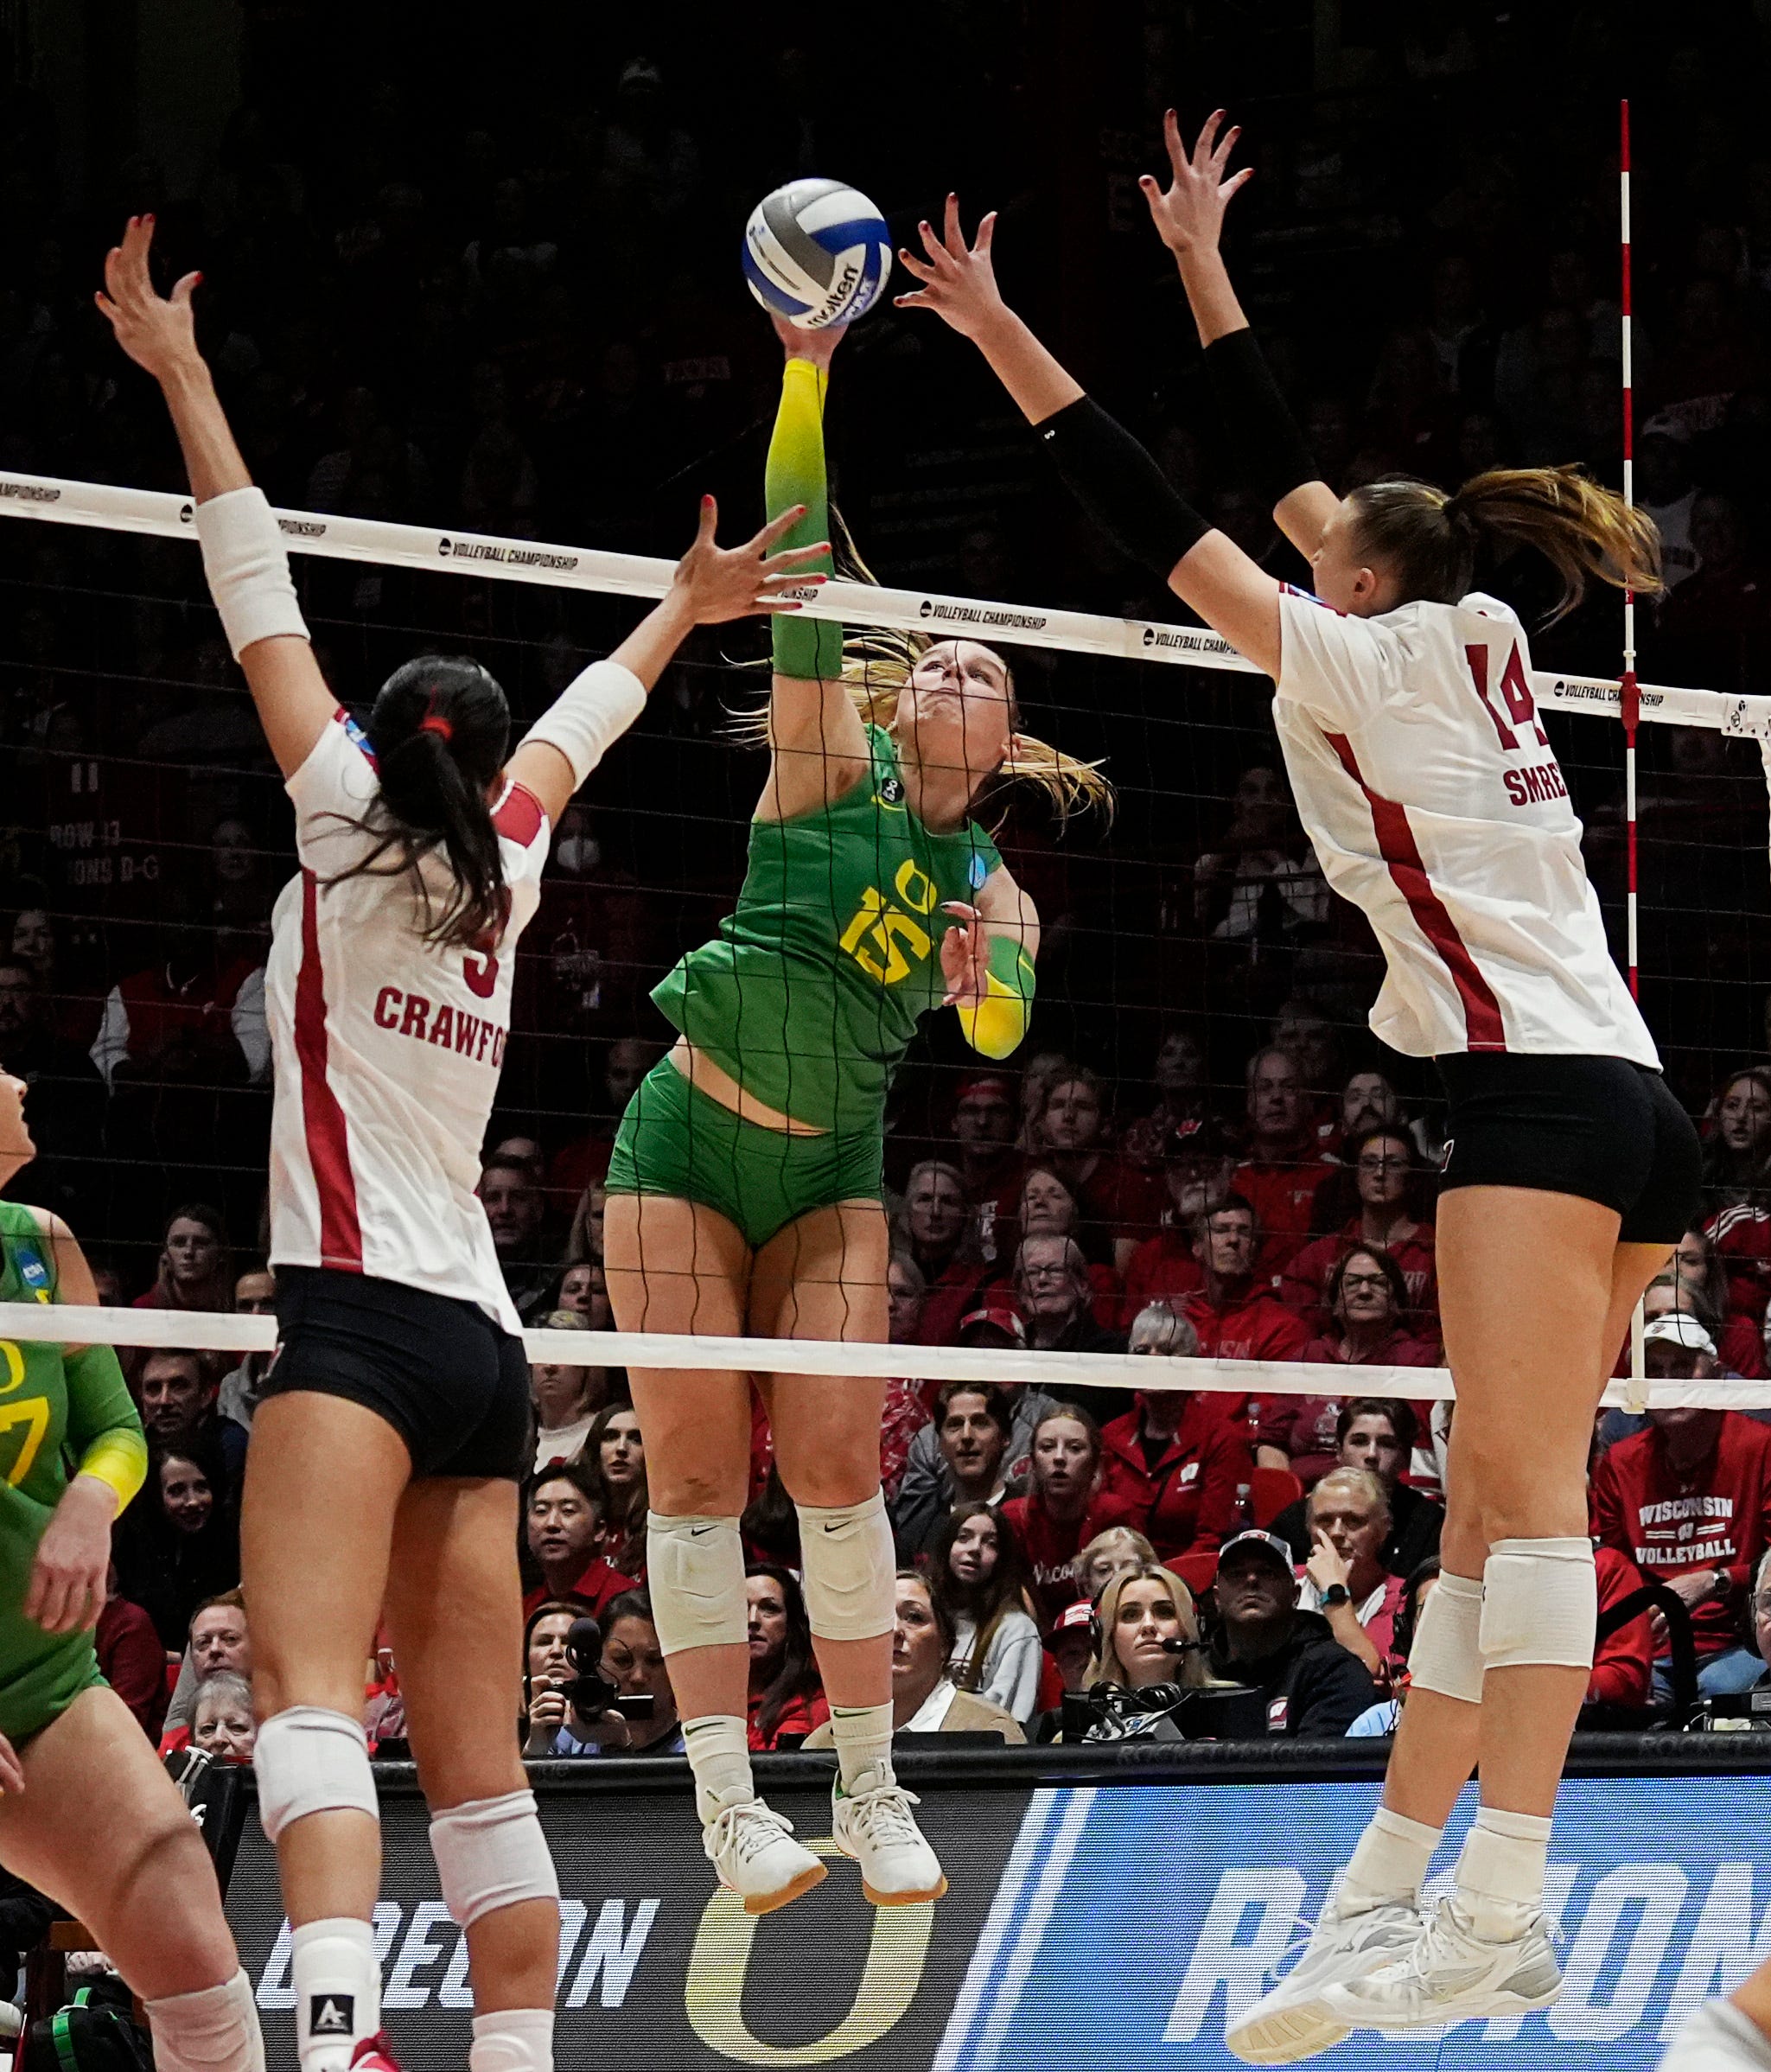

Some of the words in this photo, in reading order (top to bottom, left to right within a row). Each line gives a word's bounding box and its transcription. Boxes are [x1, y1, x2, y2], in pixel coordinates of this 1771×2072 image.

[807, 262, 859, 326] molten
[0, 482, 61, 502] AMPIONSHIP
[277, 519, 327, 537] PIONSHIP
[454, 542, 506, 562] VOLLEYBALL
[507, 549, 578, 571] CHAMPIONSHIP
[933, 604, 982, 622] VOLLEYBALL
[983, 610, 1047, 630] CHAMPIONSHIP
[1156, 632, 1202, 650] VOLLEYBALL
[1464, 636, 1550, 751] 14
[1565, 684, 1606, 701] VOLLEYBALL
[1502, 762, 1568, 806] SMRE
[839, 886, 935, 984] 15
[373, 985, 507, 1068] CRAWFO
[1639, 1496, 1733, 1527] WISCONSIN
[1635, 1538, 1736, 1565] VOLLEYBALL
